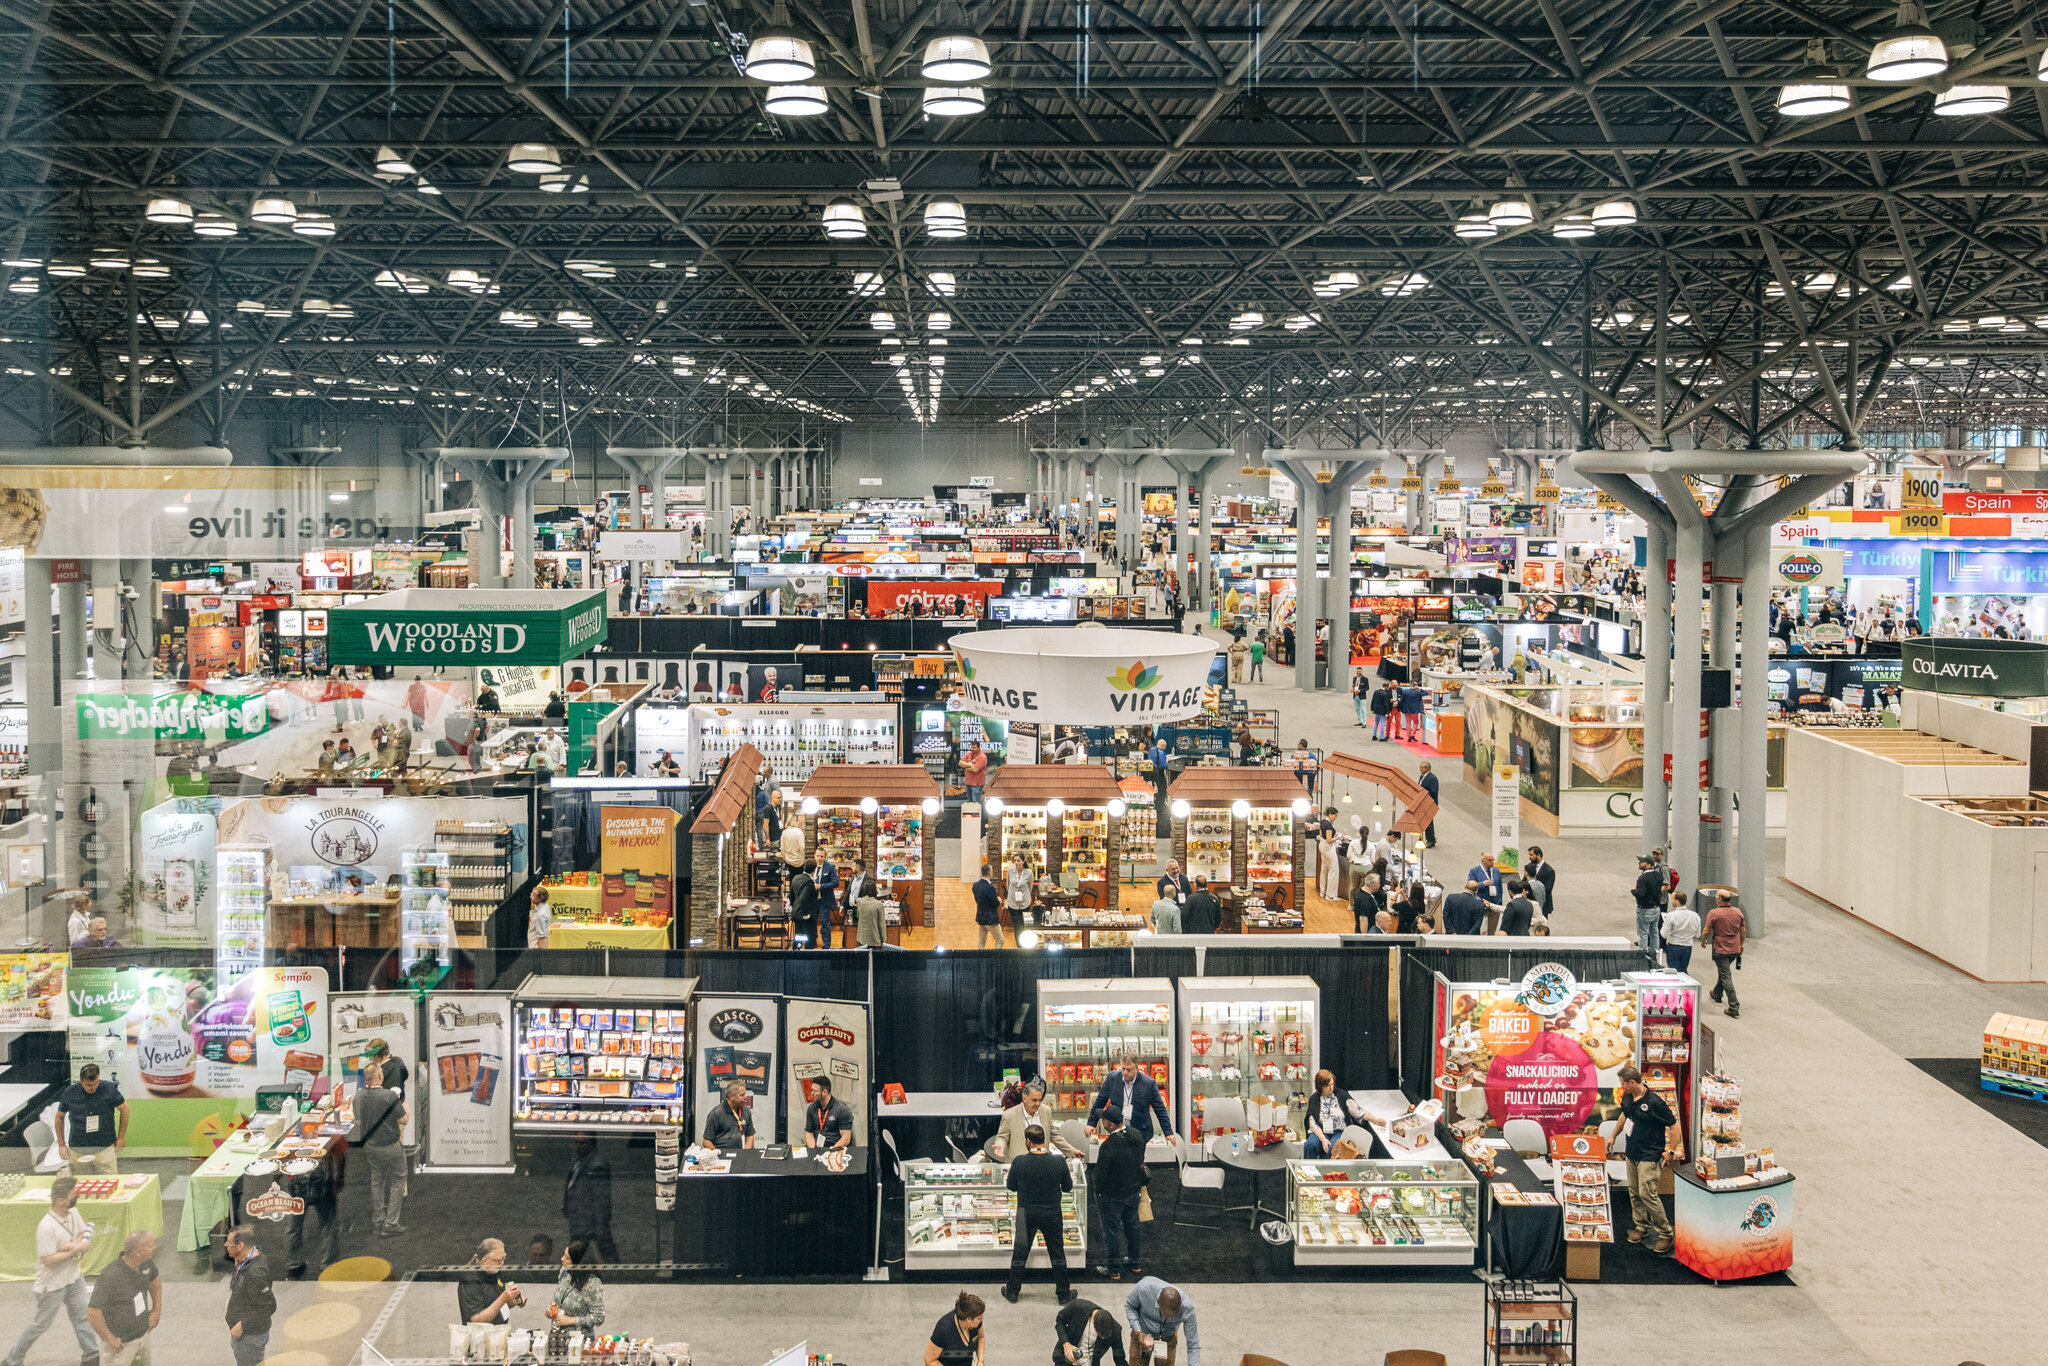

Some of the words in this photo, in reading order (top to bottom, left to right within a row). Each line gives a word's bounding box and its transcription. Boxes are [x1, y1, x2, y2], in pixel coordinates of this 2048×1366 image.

[1540, 467, 1555, 480] 2300
[1482, 486, 1504, 494] 2400
[1535, 489, 1558, 498] 2300
[1906, 479, 1939, 498] 1900
[1965, 496, 2011, 511] Spain
[1905, 515, 1938, 527] 1900
[1780, 524, 1819, 541] Spain
[841, 565, 868, 575] Stark
[1780, 563, 1821, 575] POLLY-O
[56, 572, 80, 580] HOSE
[458, 603, 499, 611] PROVIDING
[500, 603, 538, 611] SOLUTIONS
[539, 603, 554, 611] FOR
[365, 622, 526, 653] WOODLAND
[576, 622, 595, 644] FOODS
[405, 638, 492, 653] FOODS
[497, 669, 506, 684] G
[506, 665, 533, 682] Hughes
[921, 664, 938, 672] ITALY
[1912, 658, 1998, 680] COLAVITA
[503, 683, 523, 697] SUGAR
[523, 678, 537, 692] FREE
[1109, 686, 1201, 713] VINTAGE
[960, 716, 982, 725] SMALL
[1150, 712, 1168, 722] finest
[960, 725, 983, 733] BATCH
[960, 733, 985, 742] SIMPLE
[960, 741, 1003, 750] INGDIENTS
[168, 819, 183, 832] La
[304, 818, 318, 832] LA
[318, 807, 386, 834] TOURANGELLE
[606, 818, 649, 830] DISCOVER
[650, 817, 666, 828] THE
[150, 821, 204, 850] Tourangelle
[605, 827, 644, 837] AUTHENTIC
[645, 825, 666, 835] TASTE
[618, 835, 661, 848] MEXICO!
[274, 971, 312, 984] Sempio
[1523, 964, 1575, 991] ALMONDINA
[69, 981, 136, 1015] Yondu
[1502, 1009, 1529, 1017] natural
[1533, 1002, 1564, 1014] BRAND
[716, 1010, 757, 1025] LASCCO
[200, 1023, 254, 1032] Award-winning
[1488, 1017, 1530, 1033] BAKED
[800, 1028, 824, 1039] OCEAN
[824, 1028, 852, 1043] BEAUTY
[144, 1040, 192, 1069] Yondu
[1506, 1065, 1579, 1078] SNACKALICIOUS
[1517, 1079, 1552, 1090] naked
[1554, 1082, 1567, 1090] or
[1504, 1091, 1535, 1105] FULLY
[250, 1199, 275, 1211] OCEAN
[274, 1198, 302, 1209] BEAUTY
